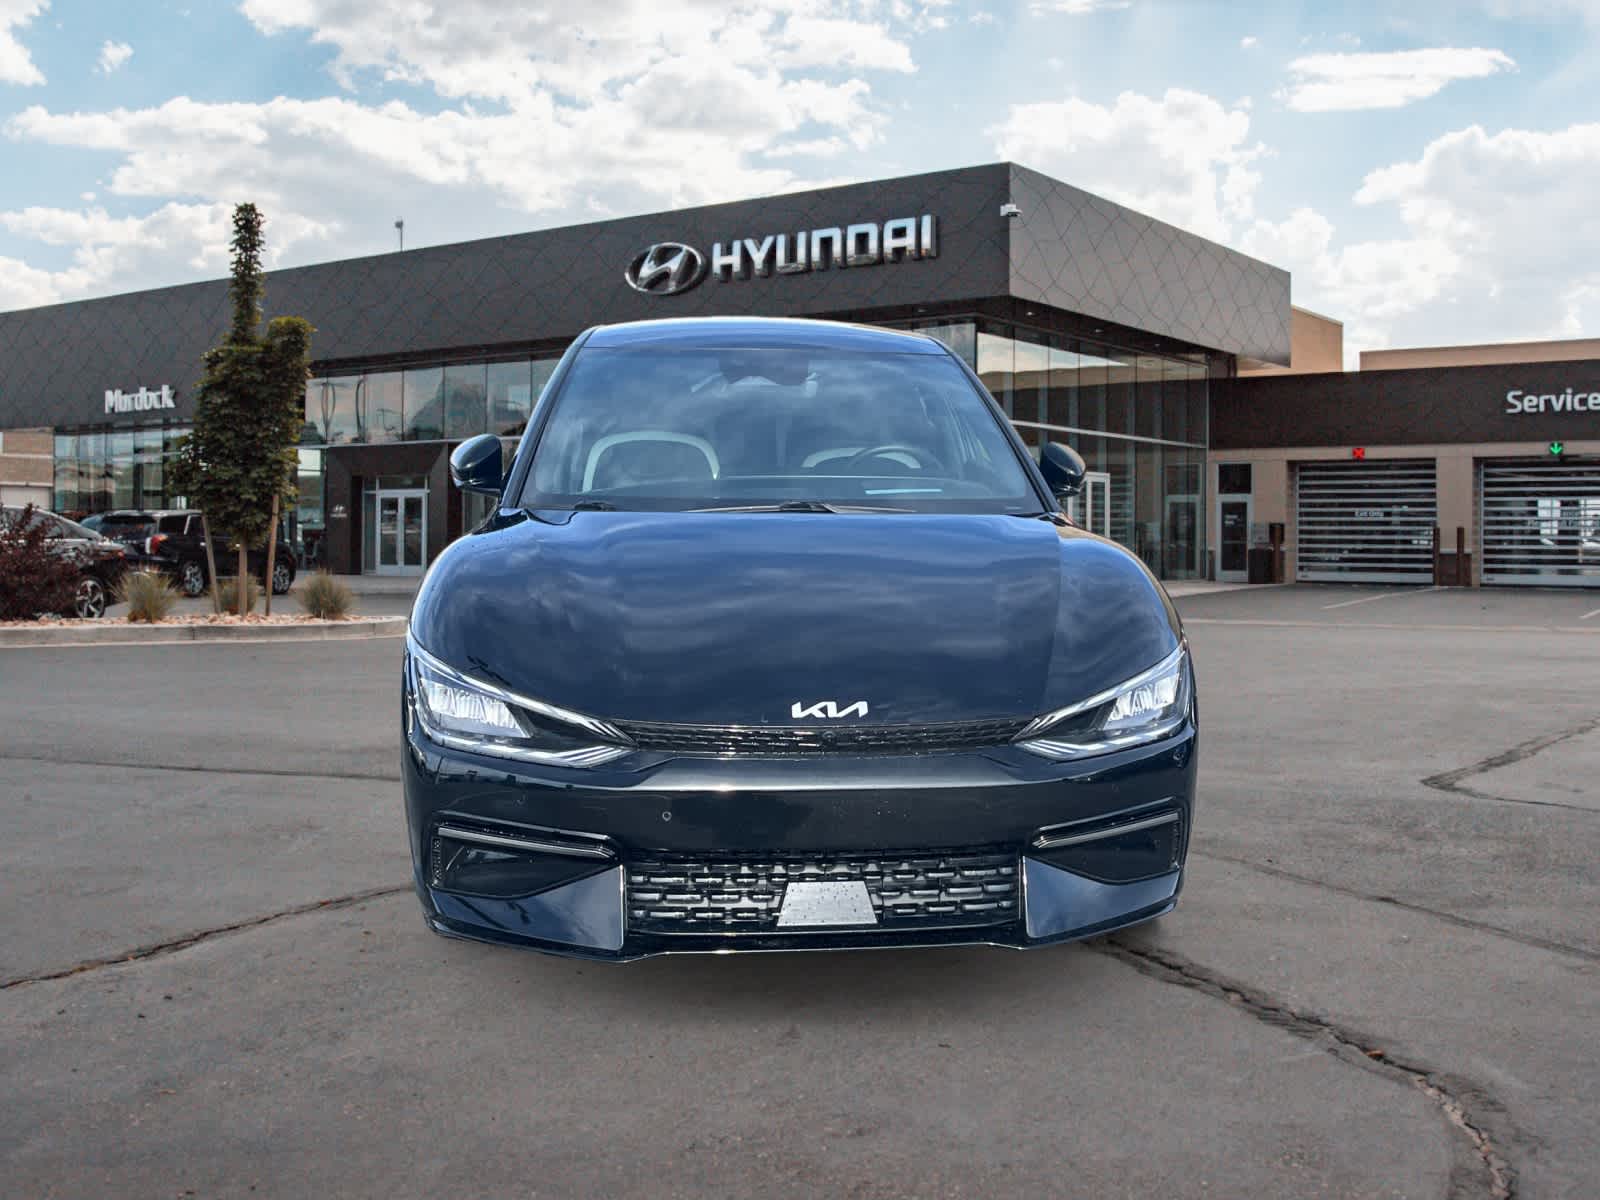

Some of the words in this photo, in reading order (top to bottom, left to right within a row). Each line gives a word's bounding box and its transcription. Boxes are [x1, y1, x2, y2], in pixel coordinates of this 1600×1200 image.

[712, 214, 937, 281] HYUNDAI
[104, 384, 176, 414] Murdock
[1505, 387, 1600, 414] Service
